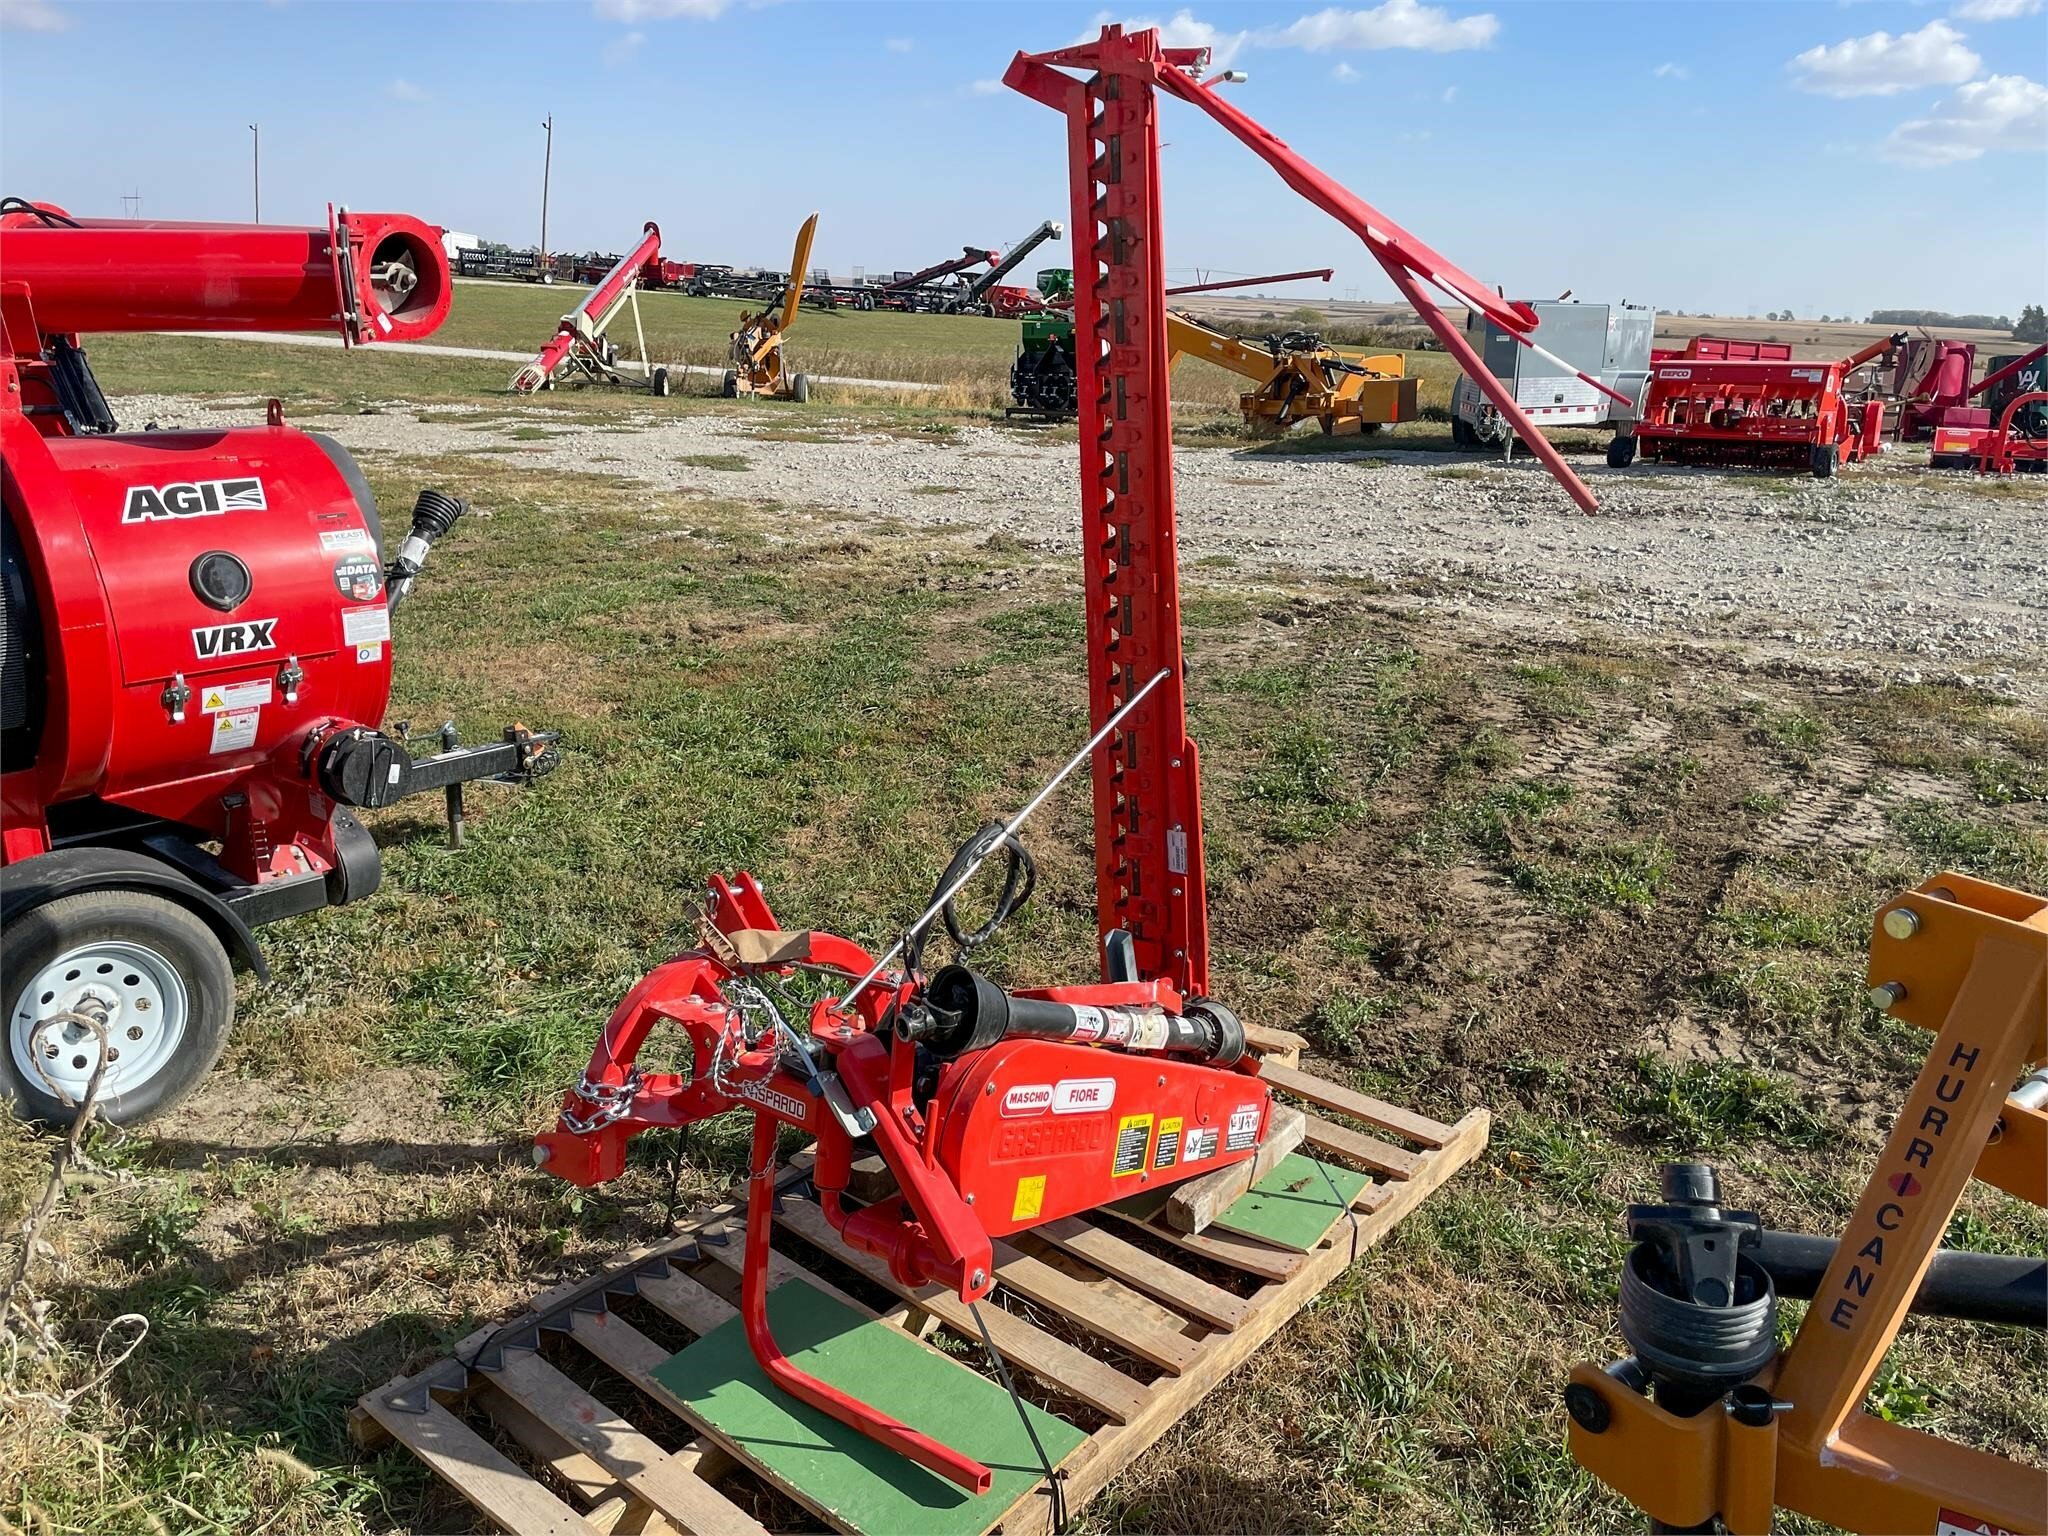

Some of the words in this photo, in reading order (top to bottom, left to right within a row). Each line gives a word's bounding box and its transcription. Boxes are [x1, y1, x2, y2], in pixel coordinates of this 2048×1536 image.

[127, 484, 220, 520] AGI
[334, 531, 363, 539] KEAST
[347, 563, 378, 575] DATA
[195, 621, 274, 656] VRX
[1009, 1090, 1050, 1105] MASCHIO
[1069, 1088, 1100, 1103] FIORE
[1828, 1042, 1981, 1331] HURRICANE
